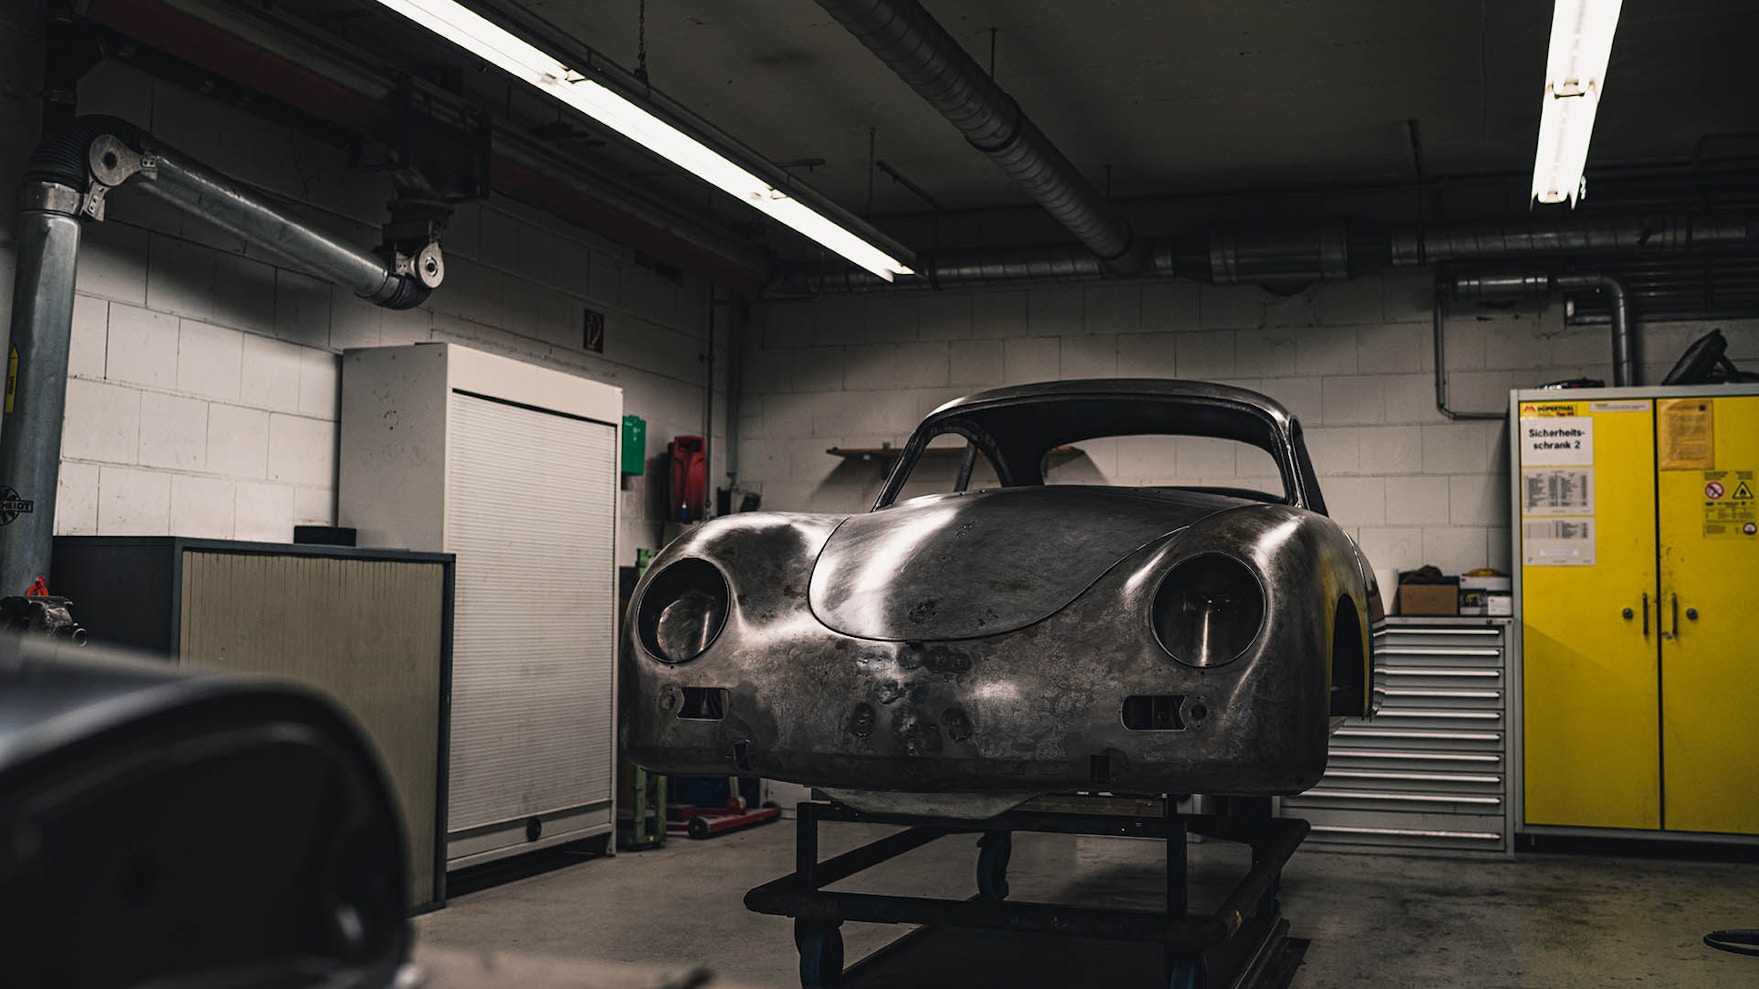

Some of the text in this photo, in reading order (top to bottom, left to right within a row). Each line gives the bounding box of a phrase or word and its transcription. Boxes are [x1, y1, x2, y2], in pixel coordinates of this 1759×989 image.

[1529, 429, 1586, 438] Sicherheits-
[1533, 440, 1581, 450] schrank 2
